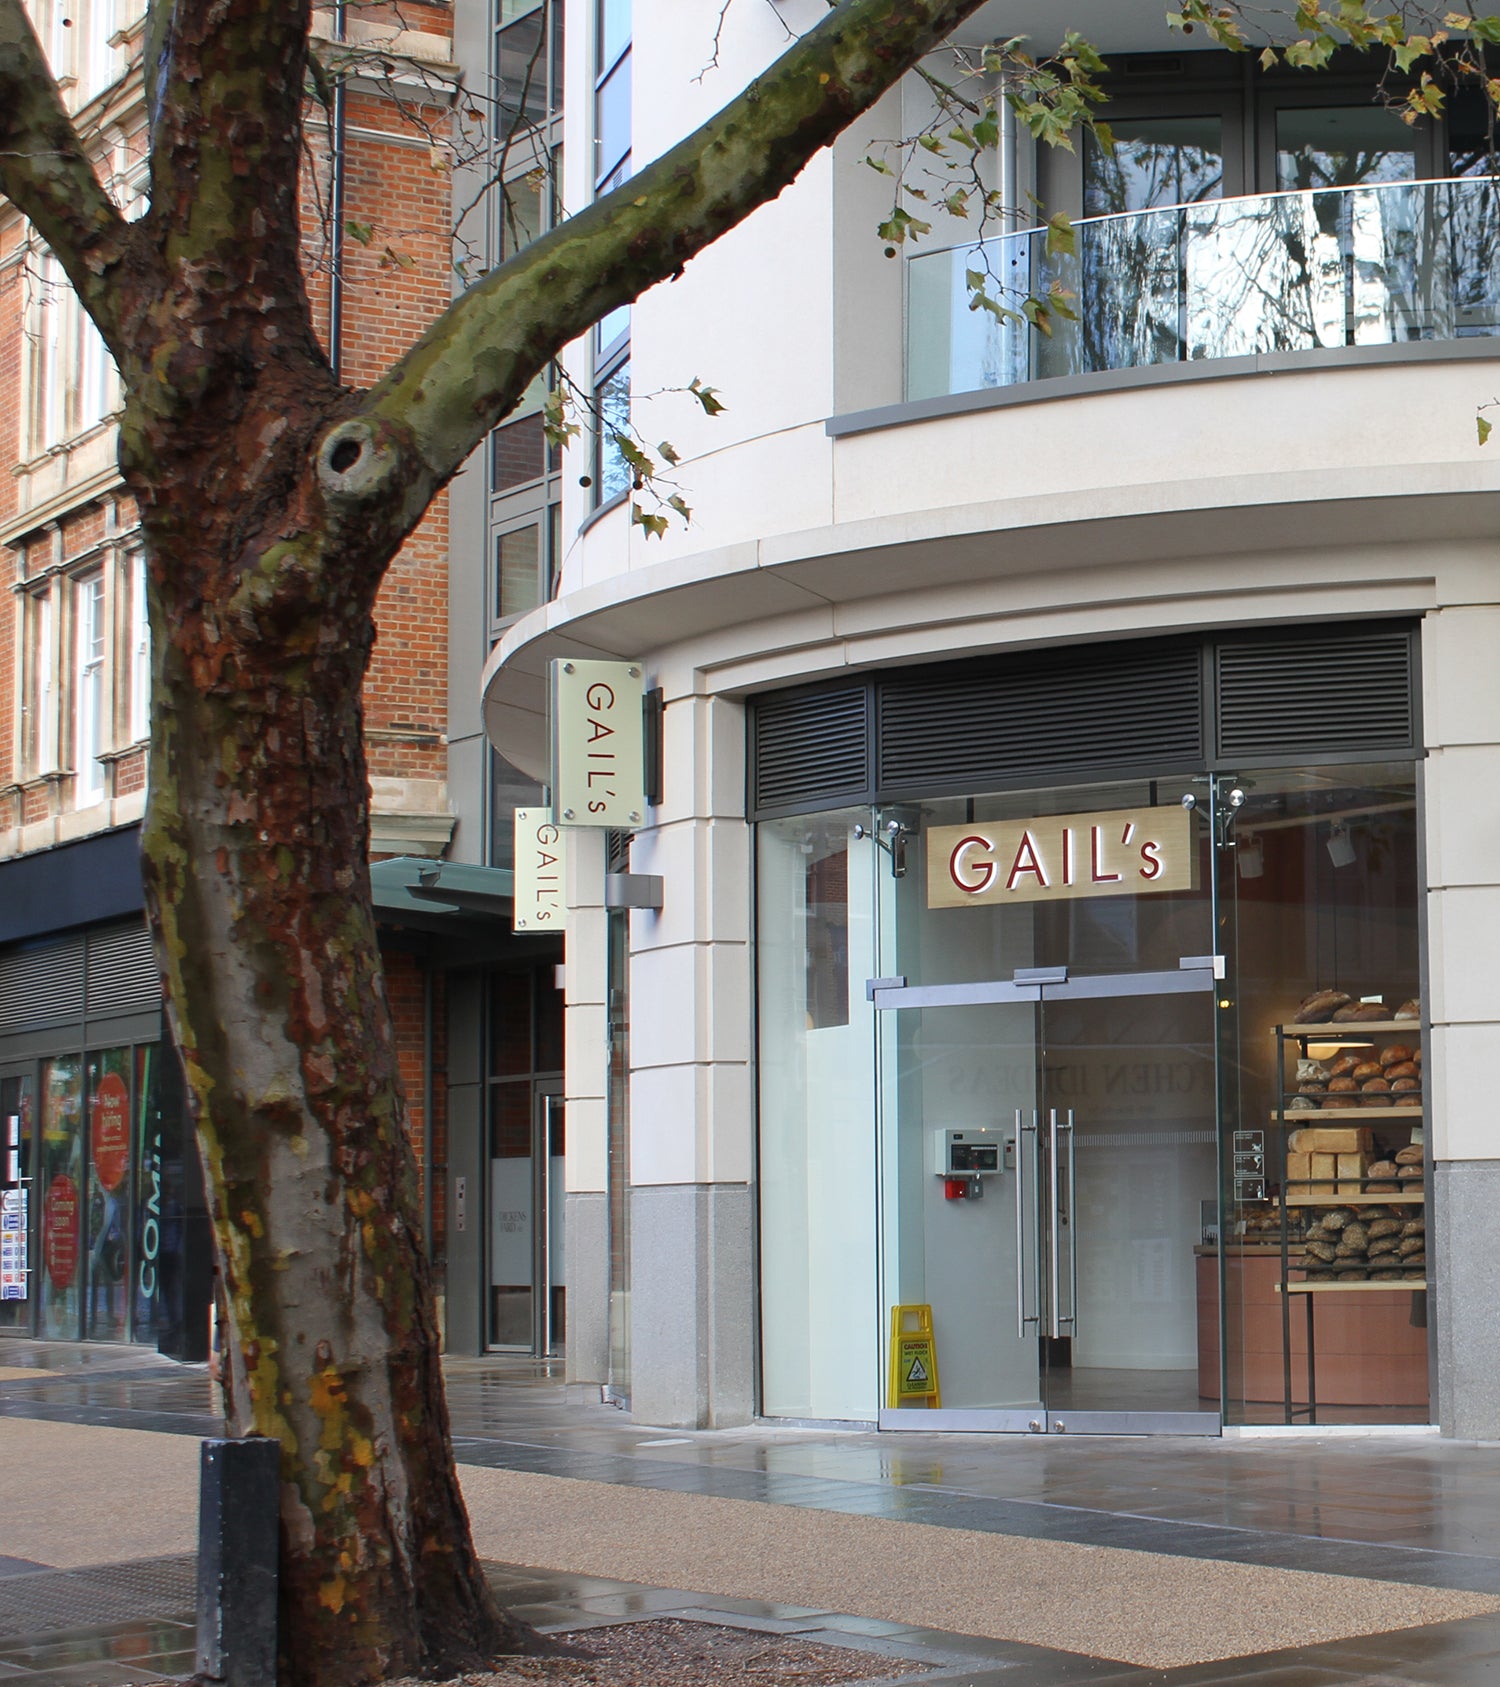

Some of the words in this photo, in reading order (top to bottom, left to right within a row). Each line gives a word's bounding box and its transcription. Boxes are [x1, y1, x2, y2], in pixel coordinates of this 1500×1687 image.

[586, 682, 616, 813] GAIL's
[536, 823, 559, 921] GAIL's
[949, 822, 1164, 894] GAIL's
